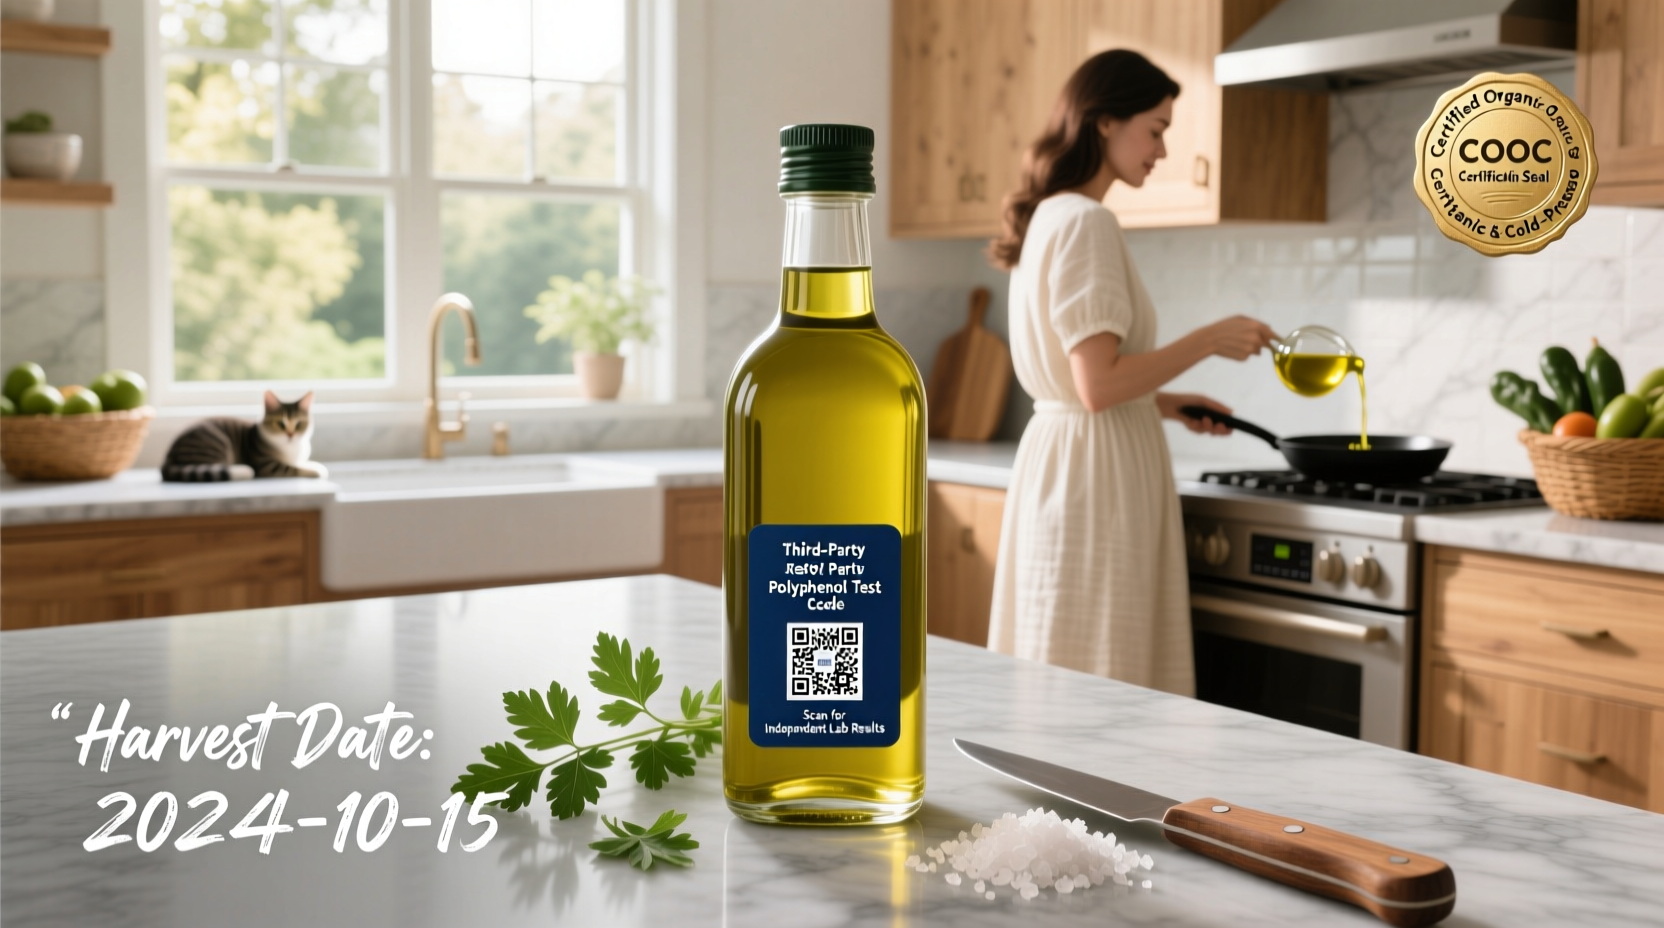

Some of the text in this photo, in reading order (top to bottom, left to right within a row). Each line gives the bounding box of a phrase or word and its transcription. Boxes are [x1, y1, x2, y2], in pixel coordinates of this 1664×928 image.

[782, 541, 866, 559] Third-Party
[768, 579, 882, 598] Polyphenol Test
[802, 708, 846, 720] Scan for
[829, 721, 848, 734] Lab
